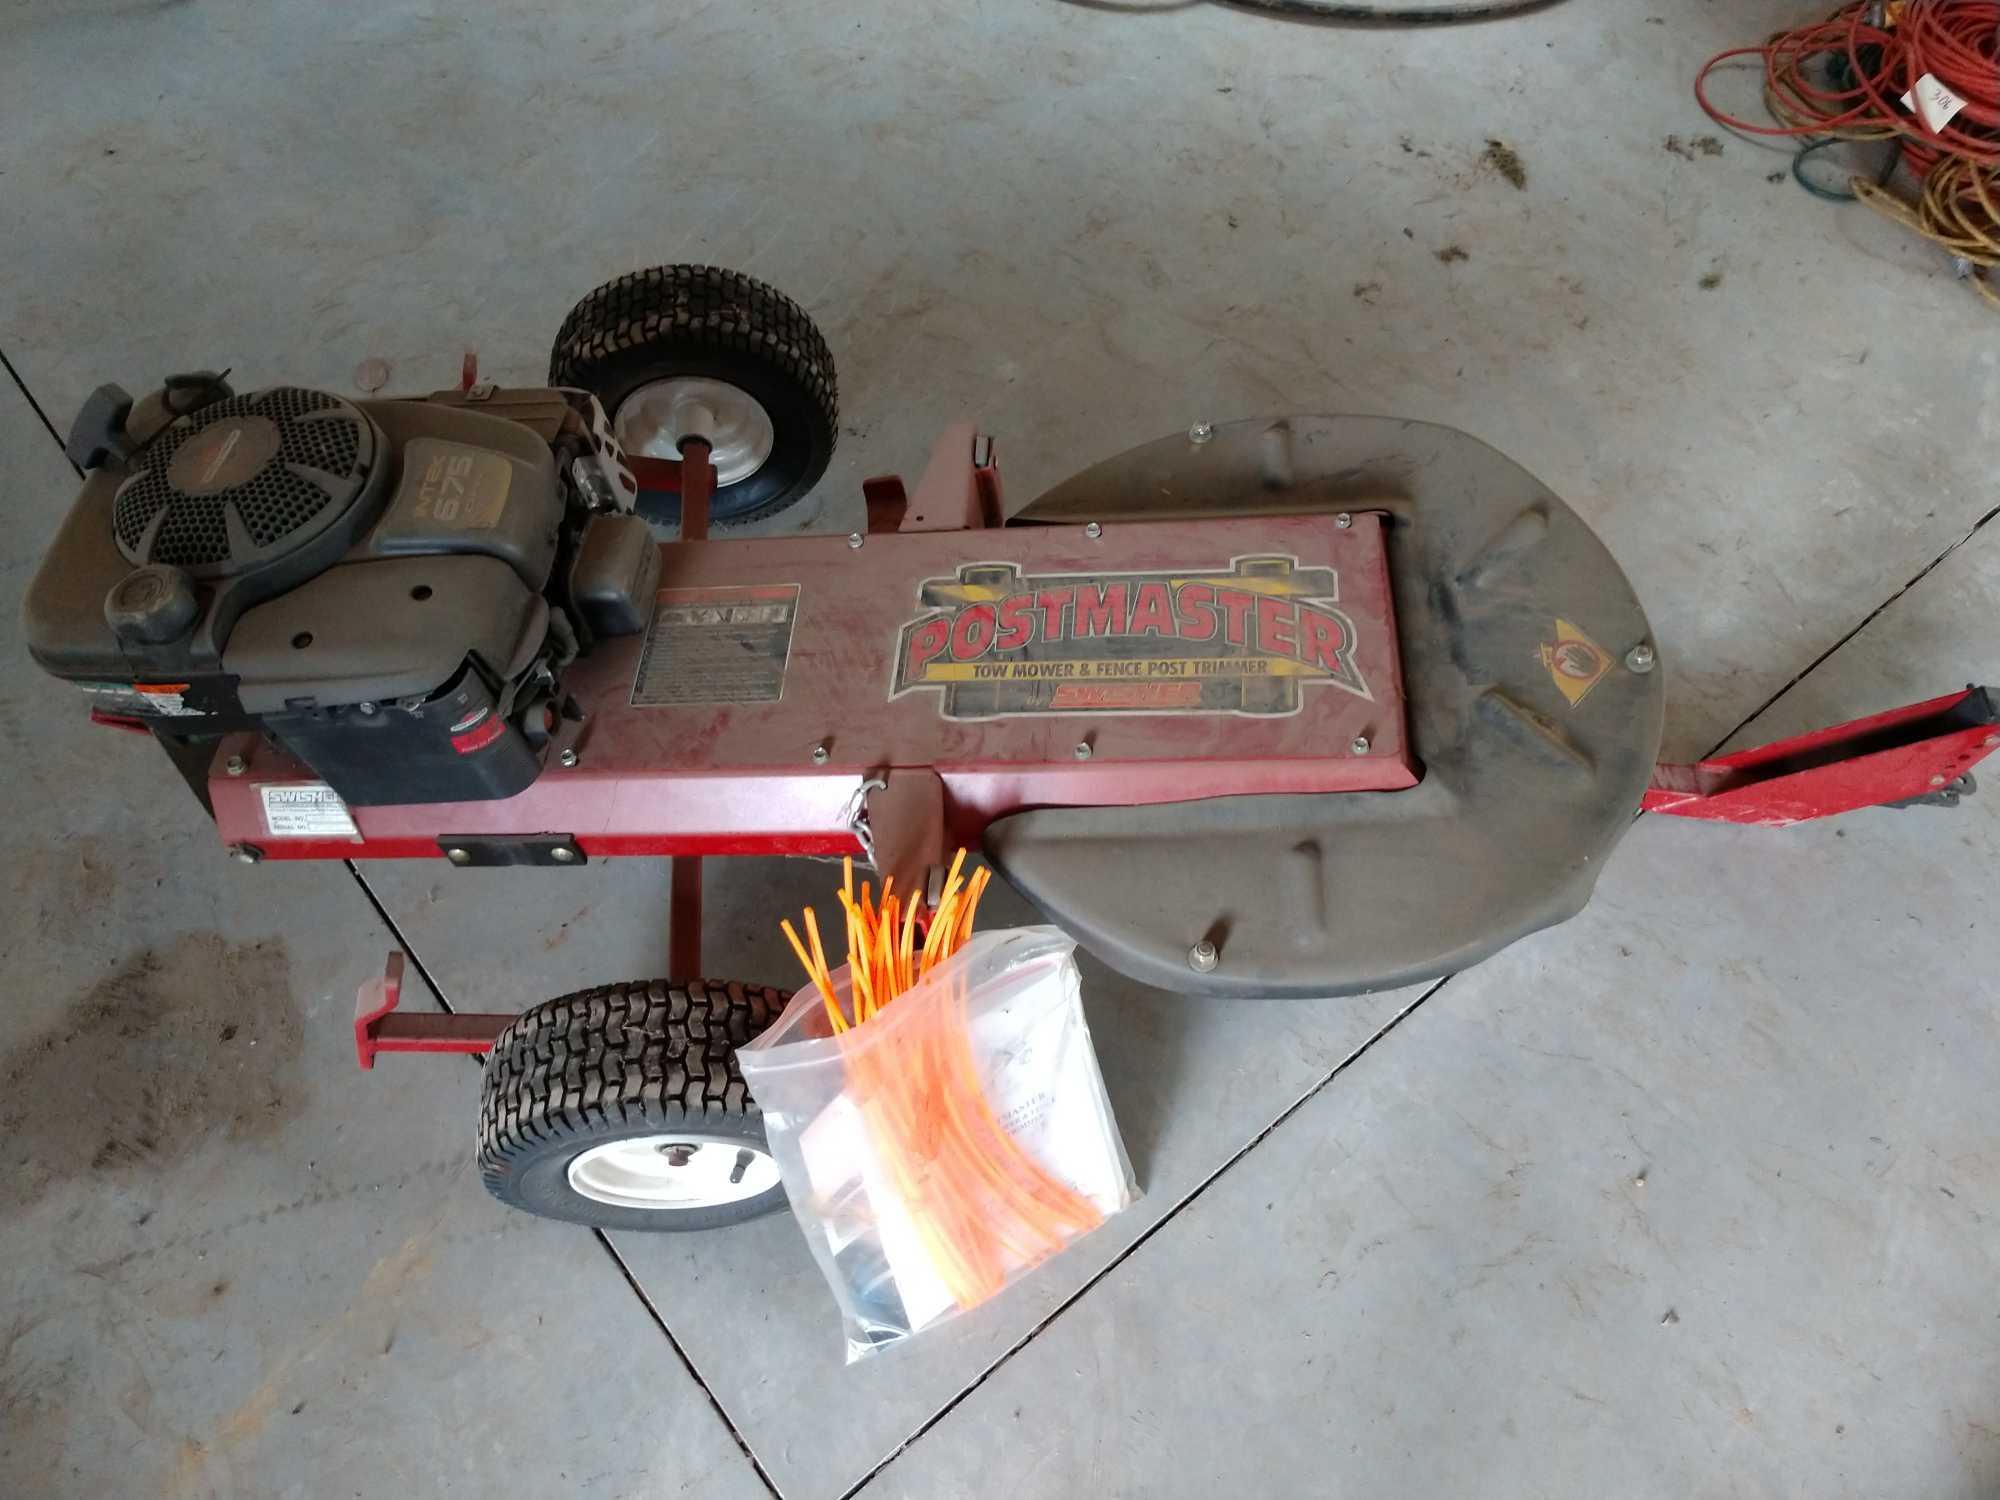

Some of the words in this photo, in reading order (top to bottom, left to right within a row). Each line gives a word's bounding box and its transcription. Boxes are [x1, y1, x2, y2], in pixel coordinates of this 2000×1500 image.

[432, 455, 474, 521] 675
[905, 582, 1348, 683] POSTMASTER
[973, 664, 1008, 678] TOW
[1012, 663, 1075, 678] MOWER
[1079, 663, 1091, 677] &
[1096, 662, 1143, 677] FENCE
[1147, 661, 1187, 676] POST
[1193, 659, 1268, 676] TRIMMER
